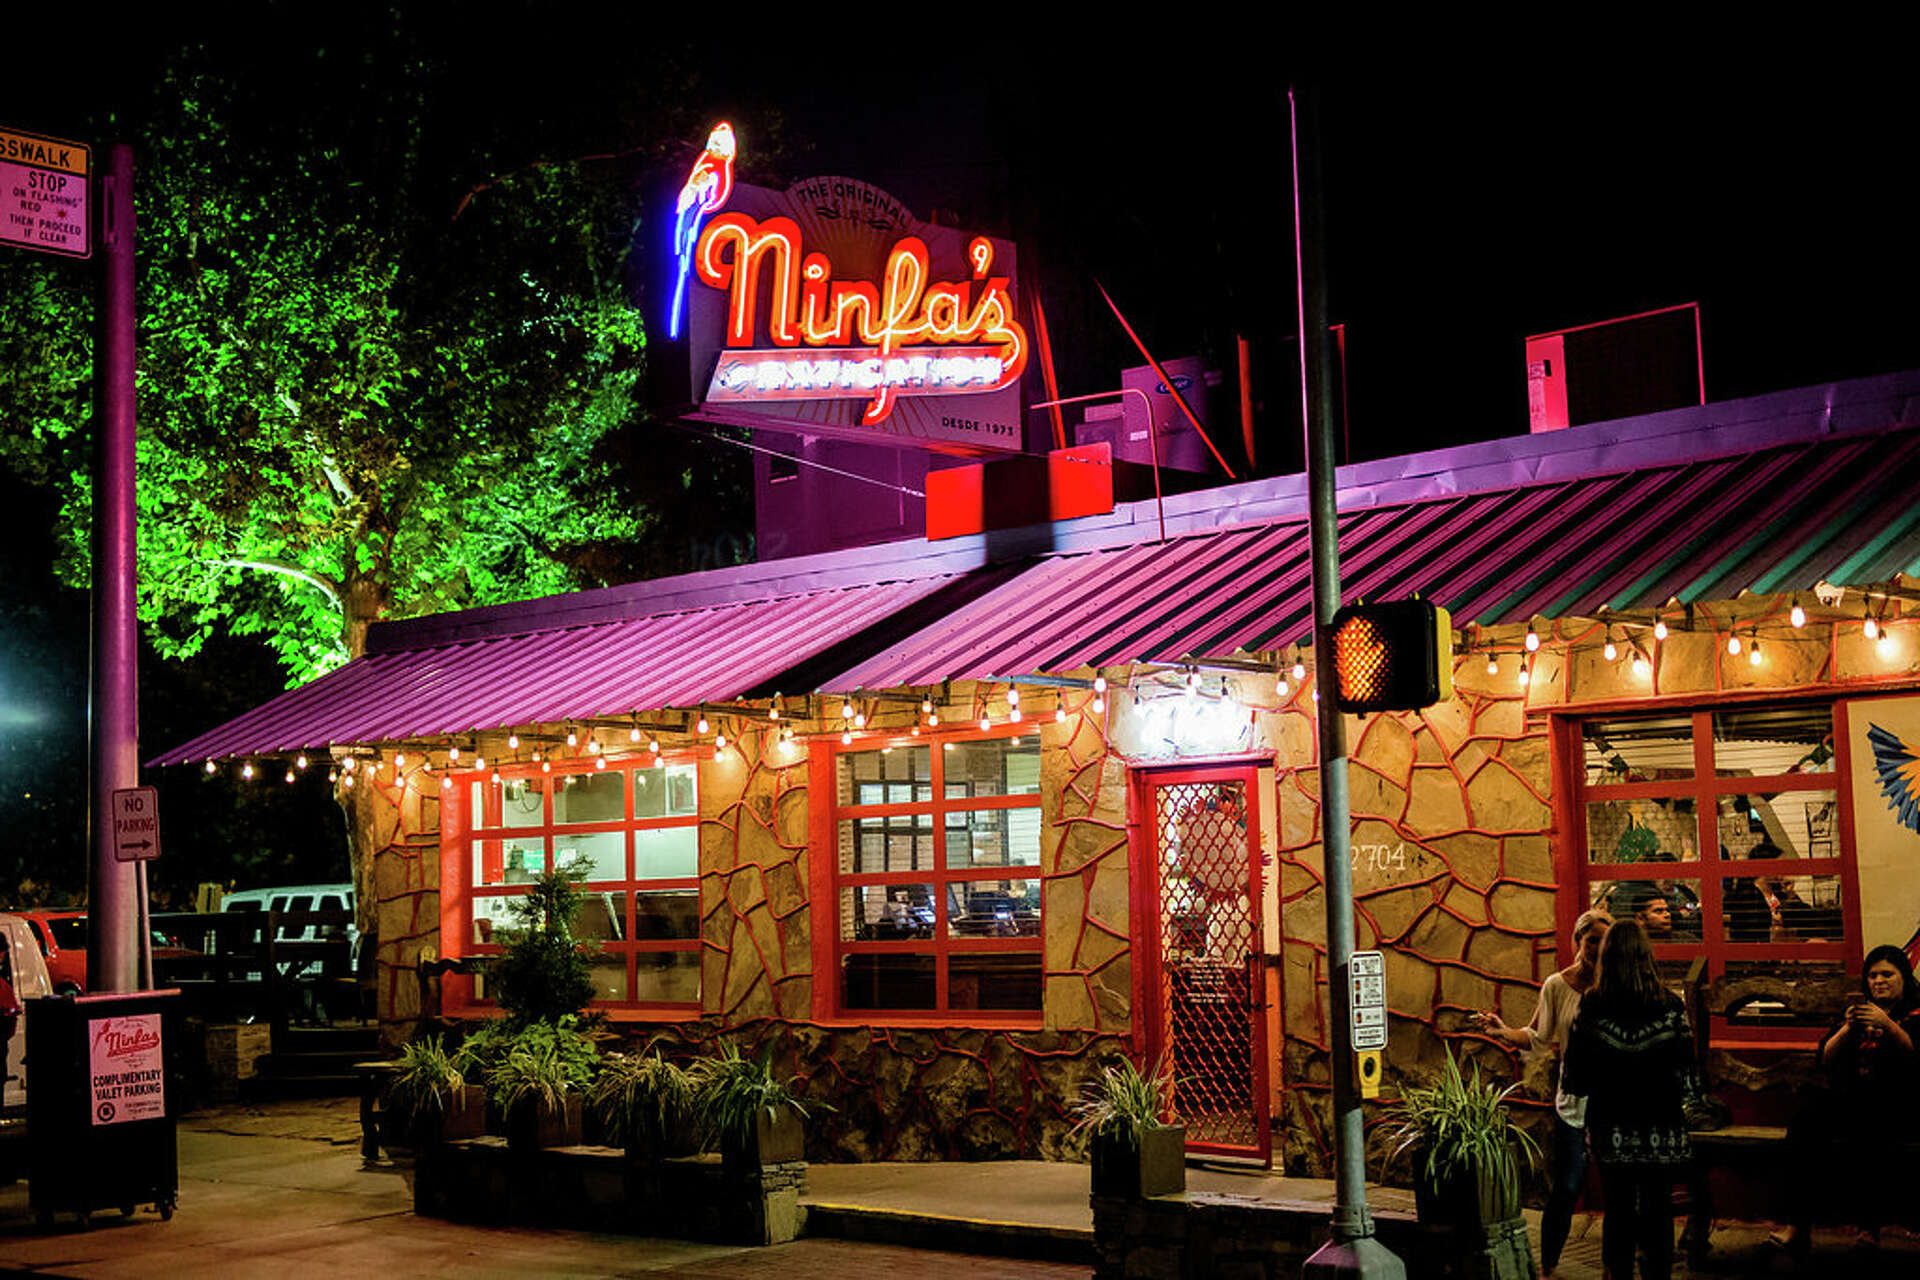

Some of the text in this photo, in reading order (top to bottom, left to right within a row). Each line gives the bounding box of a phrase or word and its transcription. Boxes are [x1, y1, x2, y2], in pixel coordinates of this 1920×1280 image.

[28, 170, 67, 193] STOP
[13, 186, 26, 198] ON
[20, 201, 41, 213] RED
[798, 183, 909, 232] THE ORIGINAL
[10, 213, 82, 236] THEN PROCEED
[24, 228, 67, 243] IF CLEAR
[696, 212, 1028, 425] Ninfa's
[942, 416, 979, 432] DESDE
[124, 797, 144, 813] NO
[117, 817, 154, 833] PARKING
[1351, 842, 1406, 872] 2704
[93, 1070, 161, 1088] COMPLIMENTARY
[95, 1082, 161, 1101] VALET PARKING
